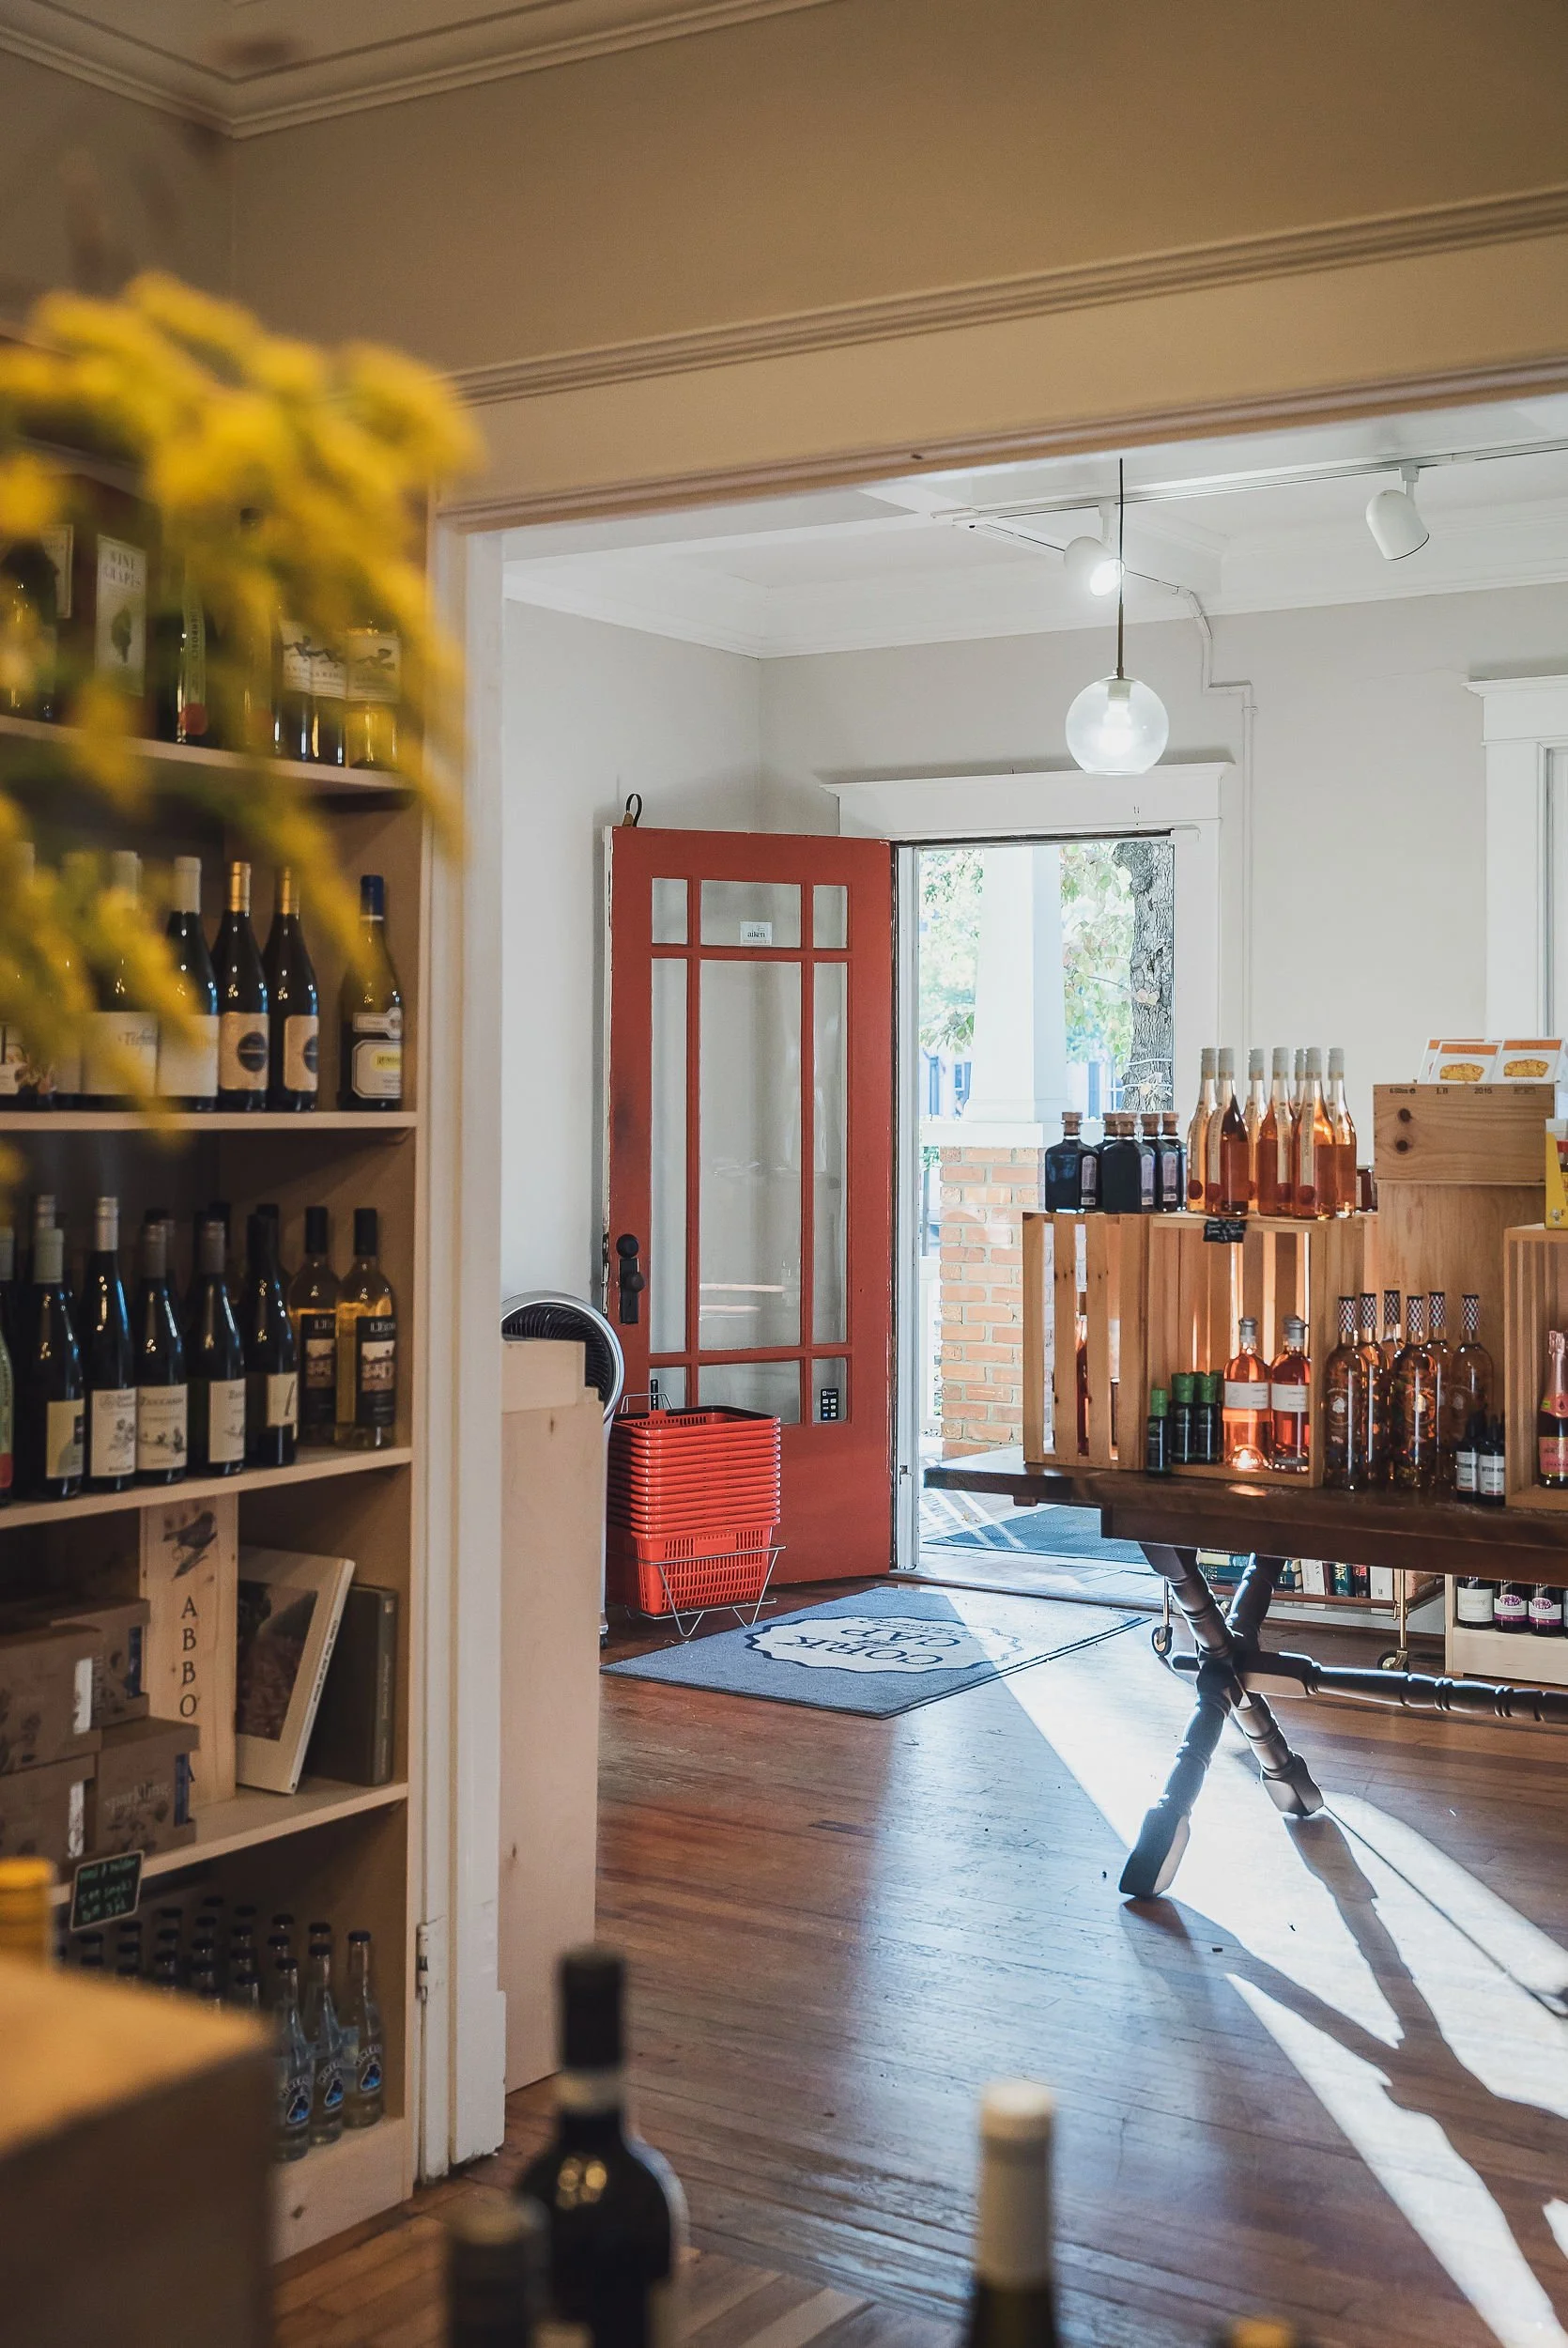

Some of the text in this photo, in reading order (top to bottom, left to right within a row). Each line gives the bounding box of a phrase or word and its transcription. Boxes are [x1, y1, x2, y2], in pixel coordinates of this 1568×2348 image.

[746, 930, 765, 938] aiken
[840, 1628, 961, 1648] CAP
[775, 1634, 945, 1666] CORK
